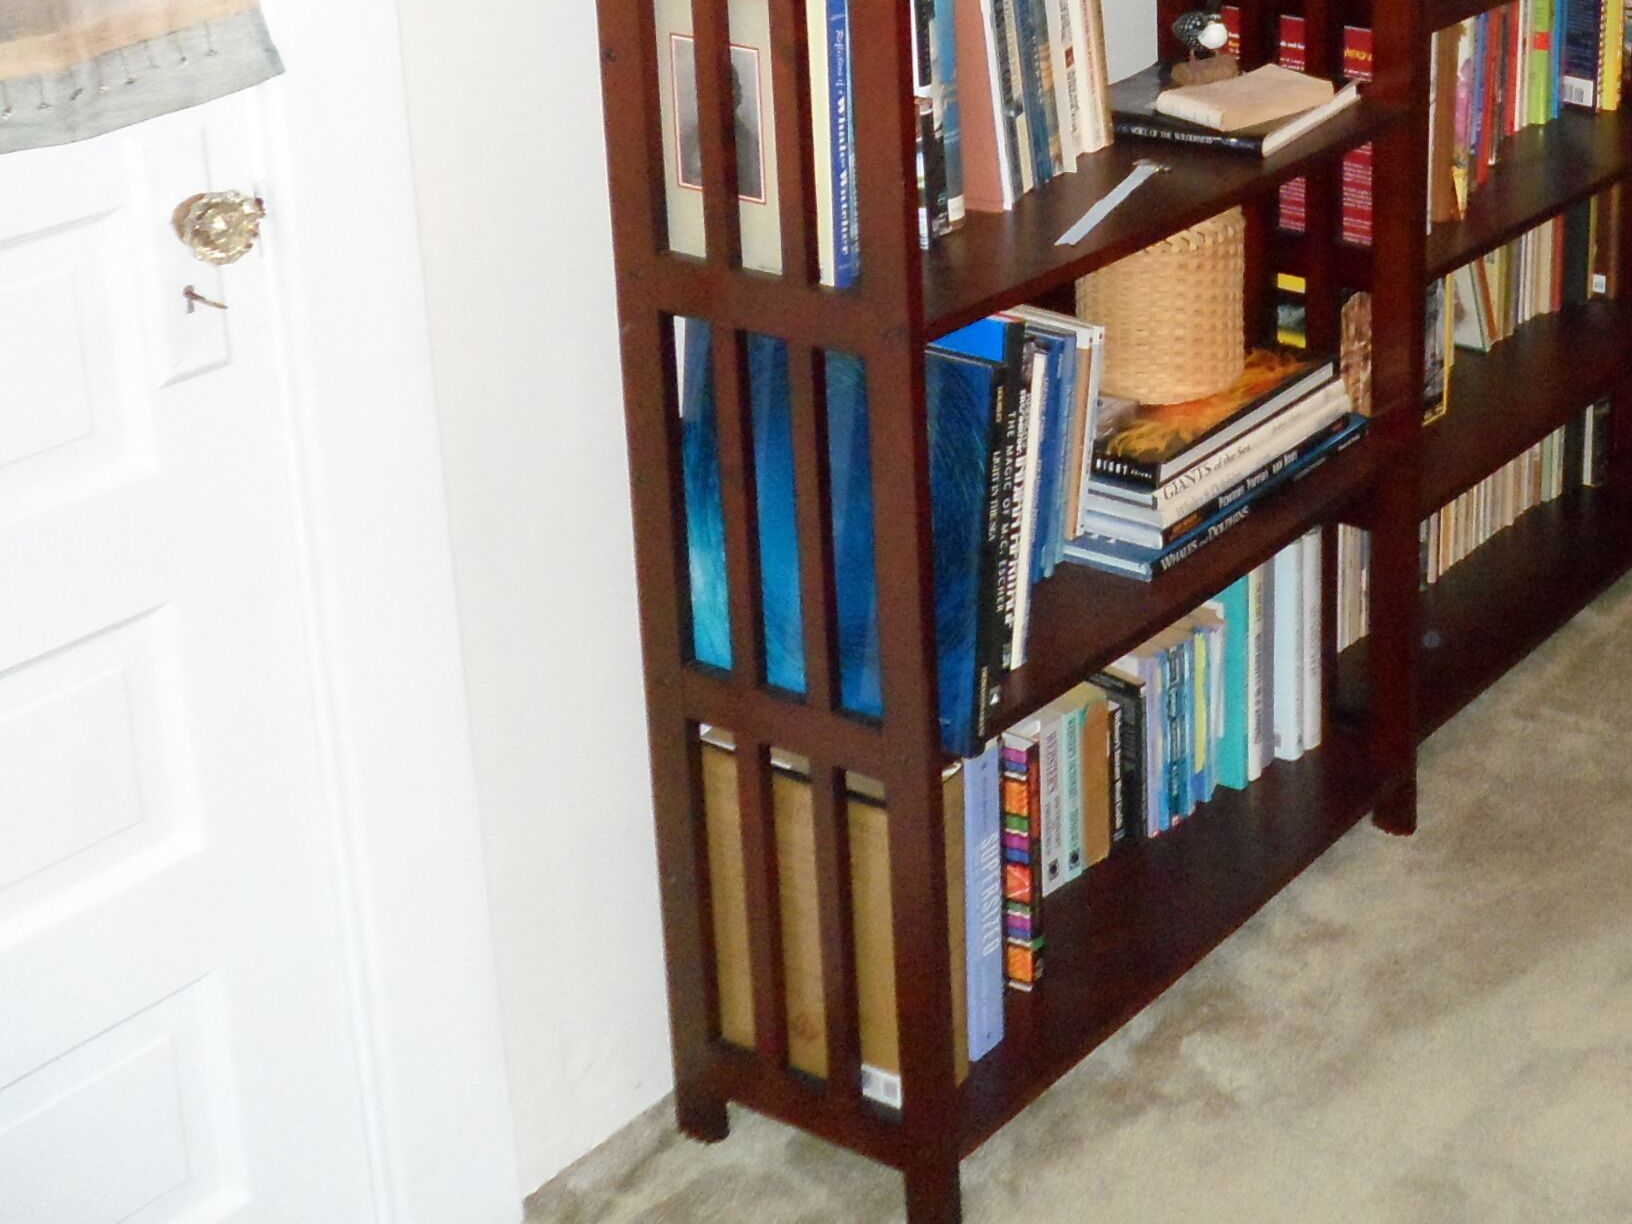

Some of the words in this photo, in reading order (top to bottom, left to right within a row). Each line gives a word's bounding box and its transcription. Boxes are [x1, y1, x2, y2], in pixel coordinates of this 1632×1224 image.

[1006, 411, 1017, 438] THE
[1003, 444, 1014, 491] MAGIC
[1163, 466, 1212, 501] GIANTS
[1212, 458, 1223, 471] of
[1001, 497, 1011, 515] OF
[1161, 539, 1198, 571] WHALES
[1207, 505, 1249, 542] DOLPHINS
[996, 559, 1007, 613] ESCHER
[1046, 731, 1058, 795] WEBSTER'S
[980, 832, 1001, 957] SUPERSIZED
